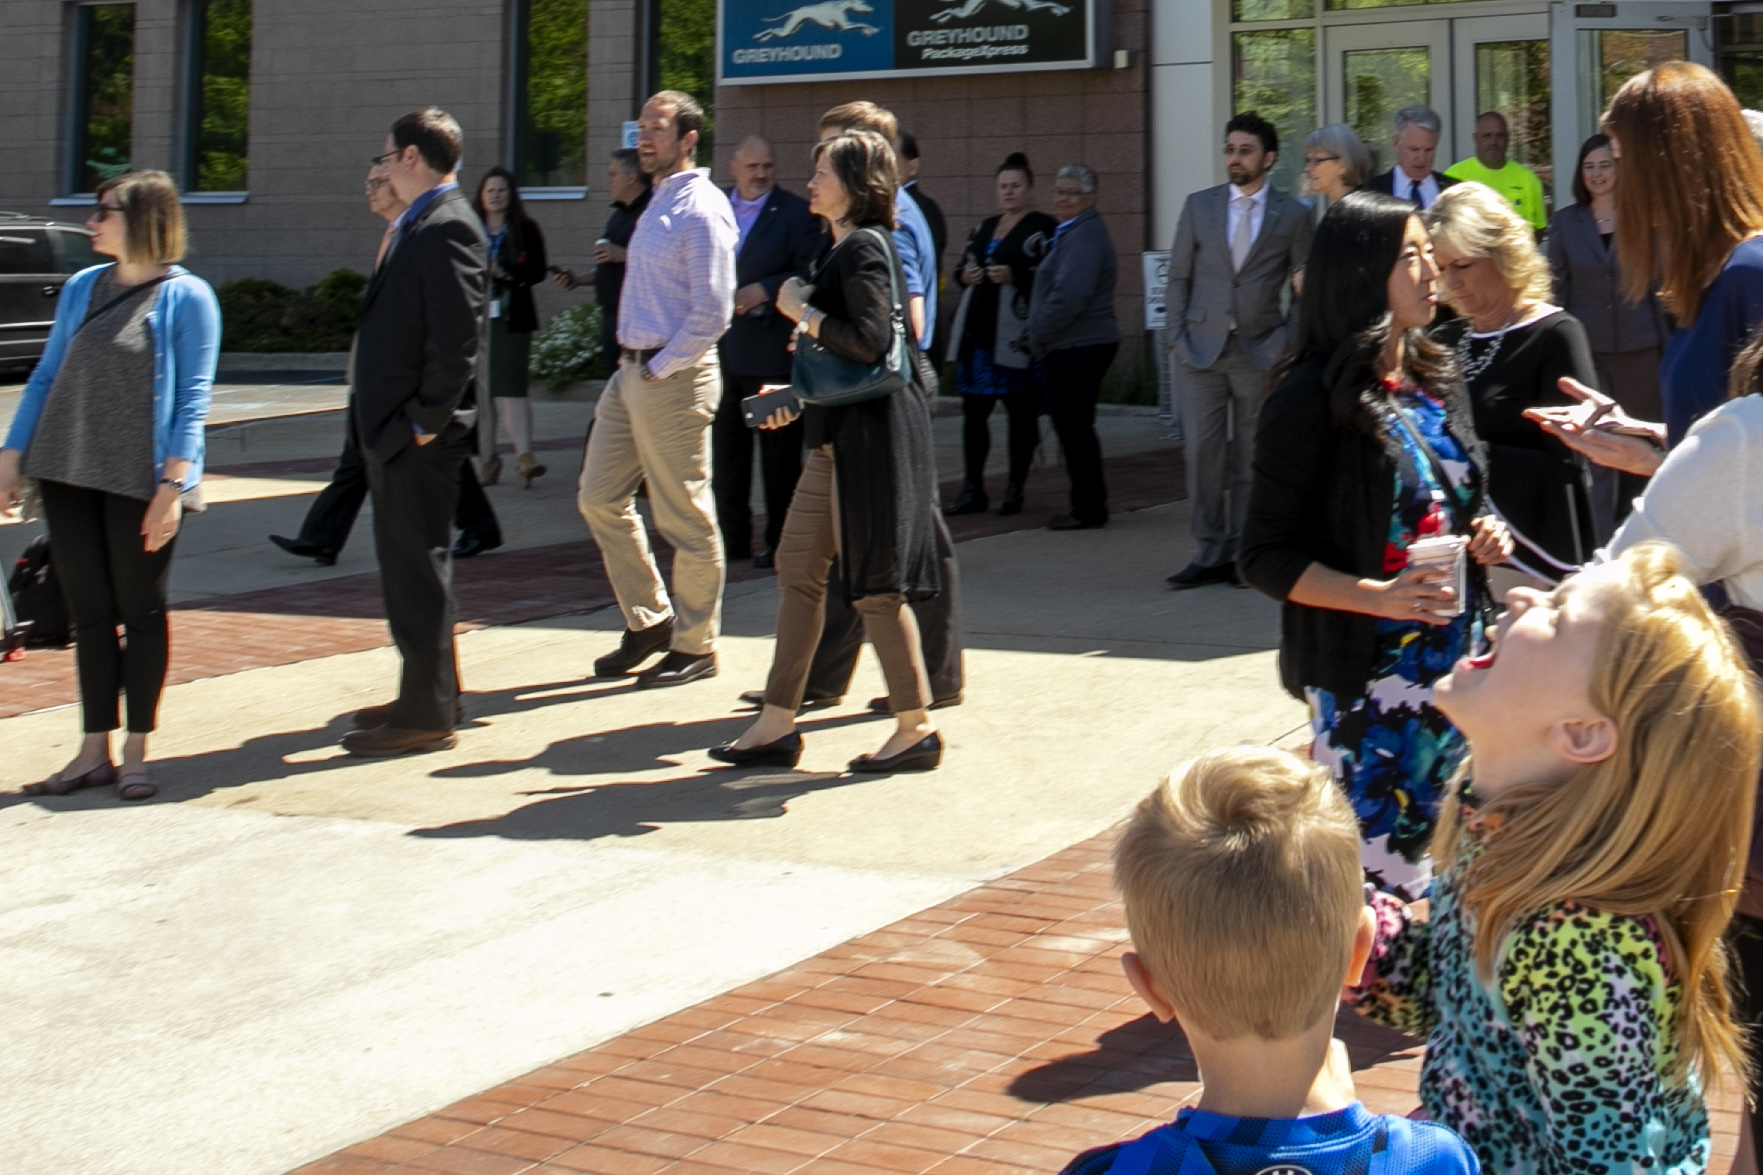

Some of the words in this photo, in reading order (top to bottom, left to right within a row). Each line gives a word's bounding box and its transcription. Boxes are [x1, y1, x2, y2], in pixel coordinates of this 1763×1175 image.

[908, 25, 1030, 47] GREYHOUND
[732, 44, 842, 64] GREYHOUND
[922, 43, 1029, 60] PackageXpress
